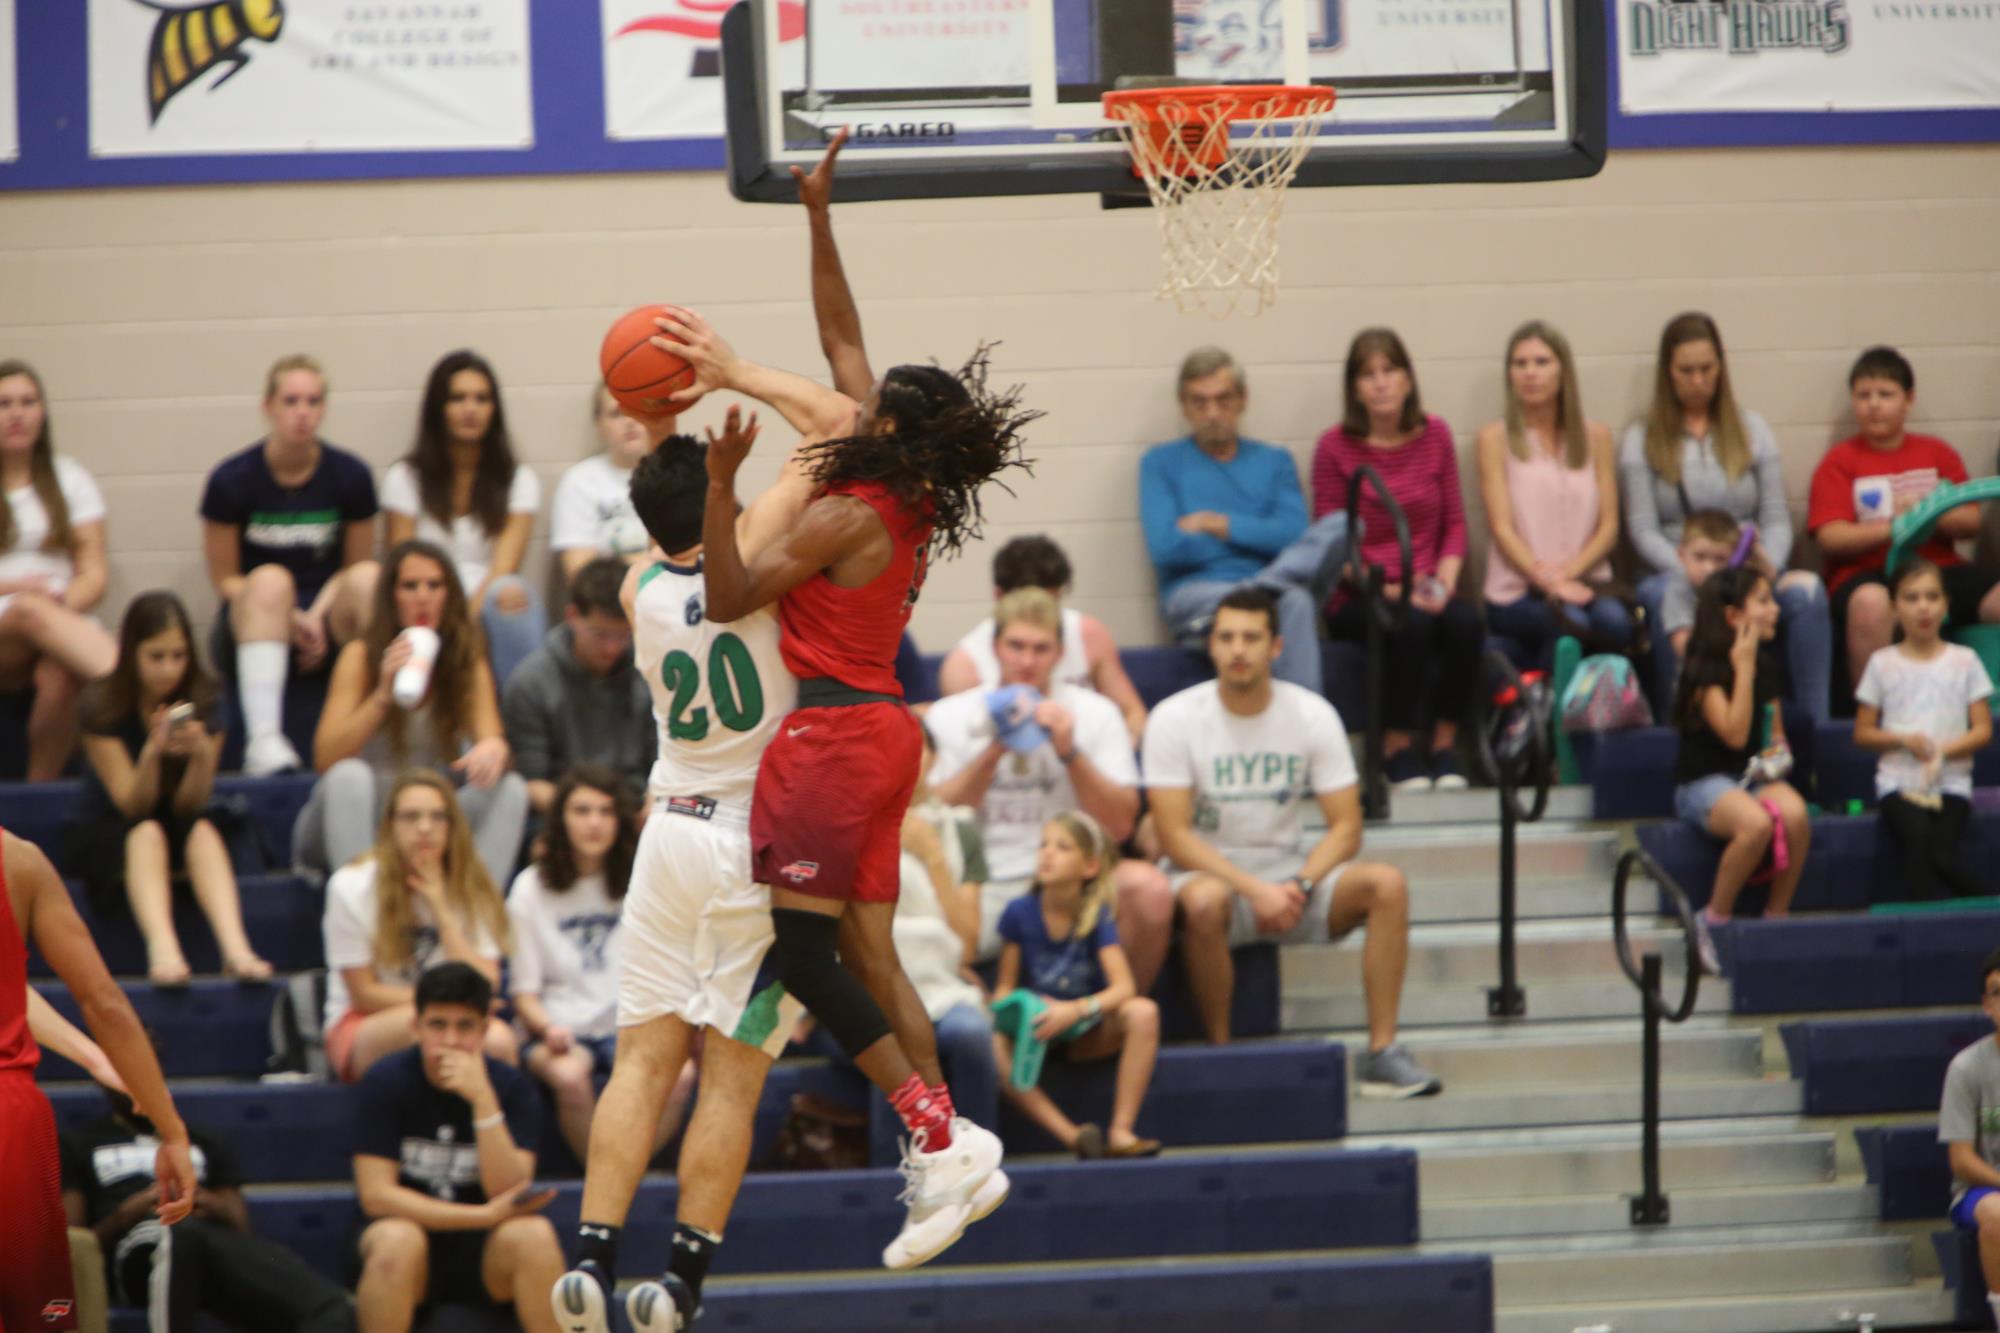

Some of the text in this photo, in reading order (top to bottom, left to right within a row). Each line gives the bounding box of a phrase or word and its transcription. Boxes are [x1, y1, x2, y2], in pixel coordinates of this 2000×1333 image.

[1377, 9, 1512, 27] UNIVERSIT
[1872, 3, 2000, 20] UNIVERSIT
[856, 122, 955, 139] GARED
[661, 631, 764, 741] 20
